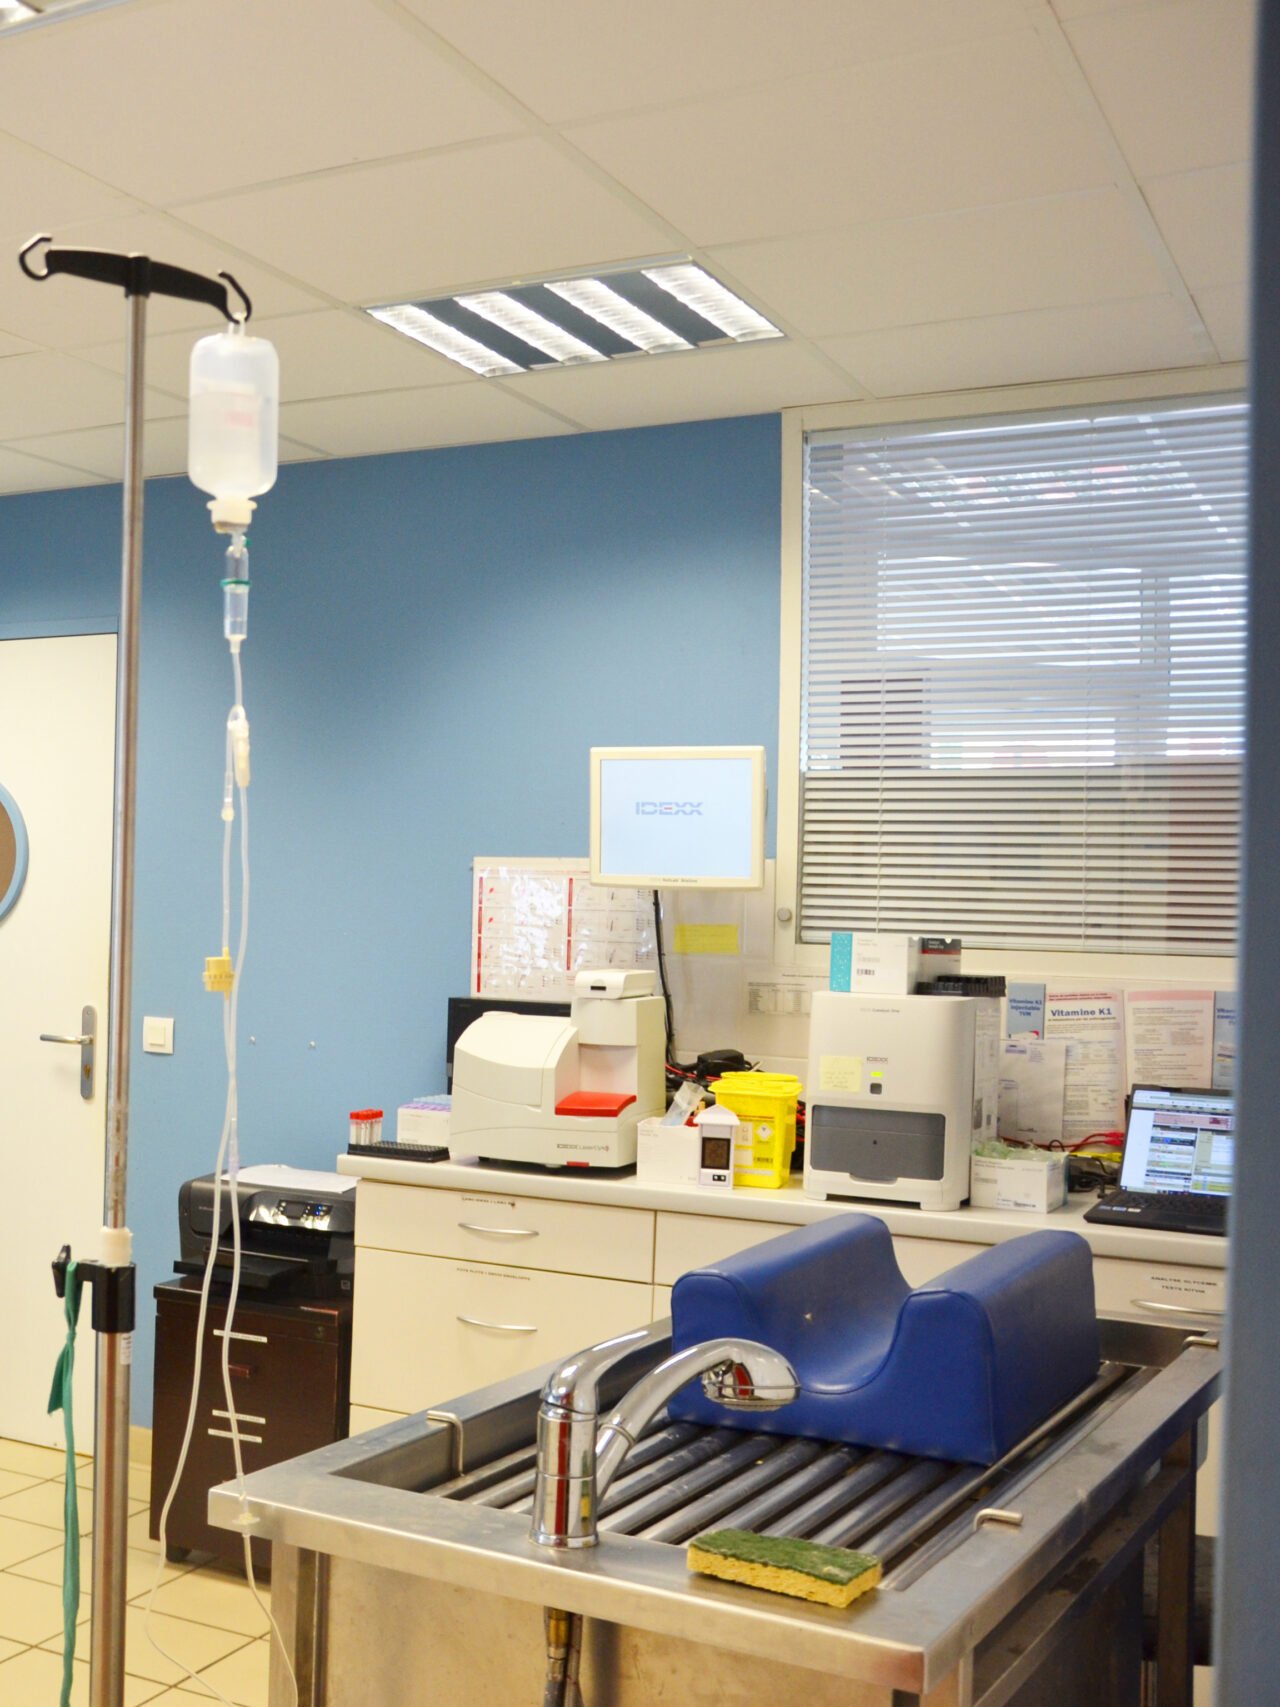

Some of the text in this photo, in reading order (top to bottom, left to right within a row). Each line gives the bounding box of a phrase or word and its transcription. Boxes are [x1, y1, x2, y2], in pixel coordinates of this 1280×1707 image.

[635, 801, 703, 815] IDEXX
[1051, 1007, 1113, 1017] Vitamine K1
